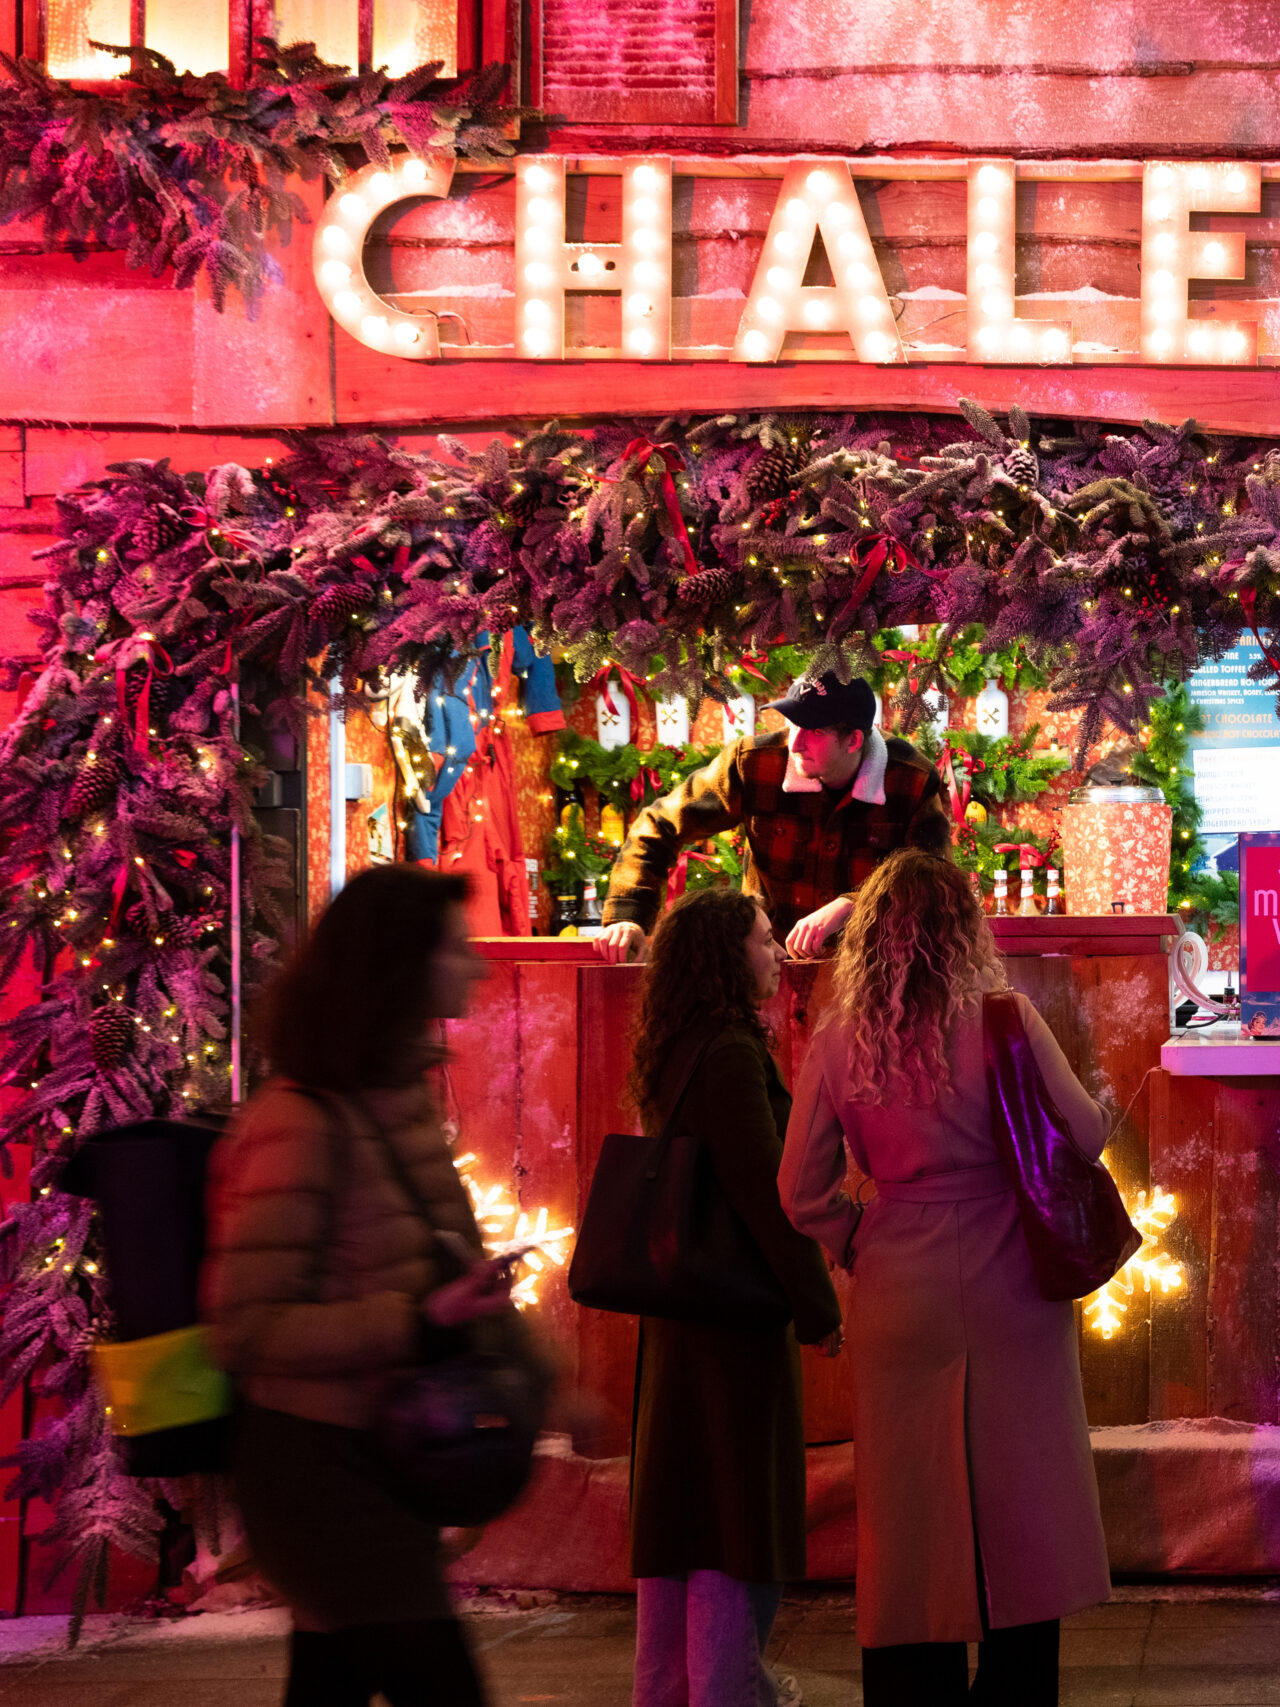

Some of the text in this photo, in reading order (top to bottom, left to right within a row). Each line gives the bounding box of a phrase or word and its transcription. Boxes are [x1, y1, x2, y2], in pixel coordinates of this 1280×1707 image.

[1221, 665, 1246, 673] TOFFEE
[1190, 678, 1239, 687] GINGERBREAD
[1215, 713, 1273, 724] CHOCOLATE
